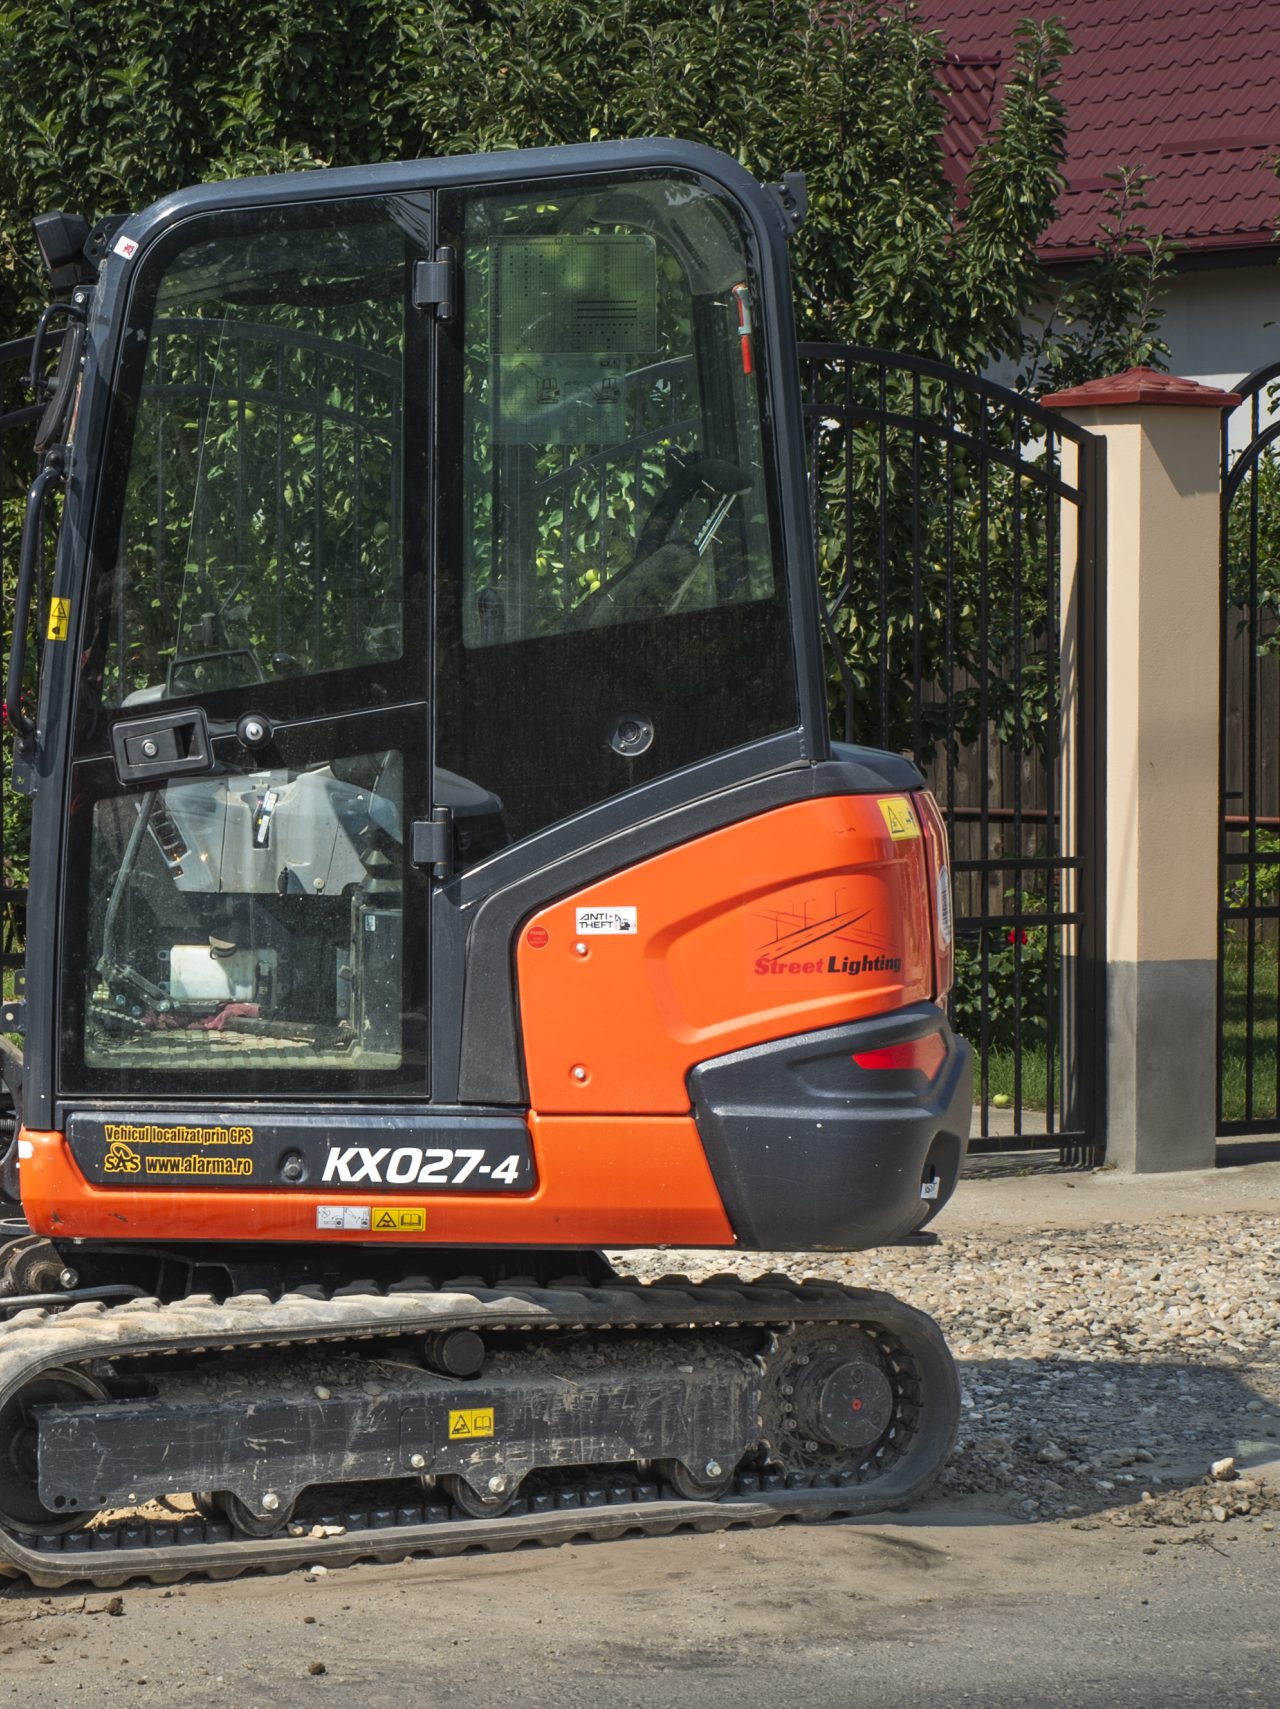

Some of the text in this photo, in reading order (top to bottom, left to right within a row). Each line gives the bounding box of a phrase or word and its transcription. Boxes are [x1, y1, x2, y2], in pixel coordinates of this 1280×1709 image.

[579, 921, 614, 929] THEFT
[580, 913, 608, 921] ANTI
[754, 954, 902, 976] Street Lighting
[104, 1124, 253, 1146] Vehicul localizat prin GPS
[104, 1149, 253, 1176] SAS www.alarma.ro
[321, 1147, 520, 1184] KX027-4
